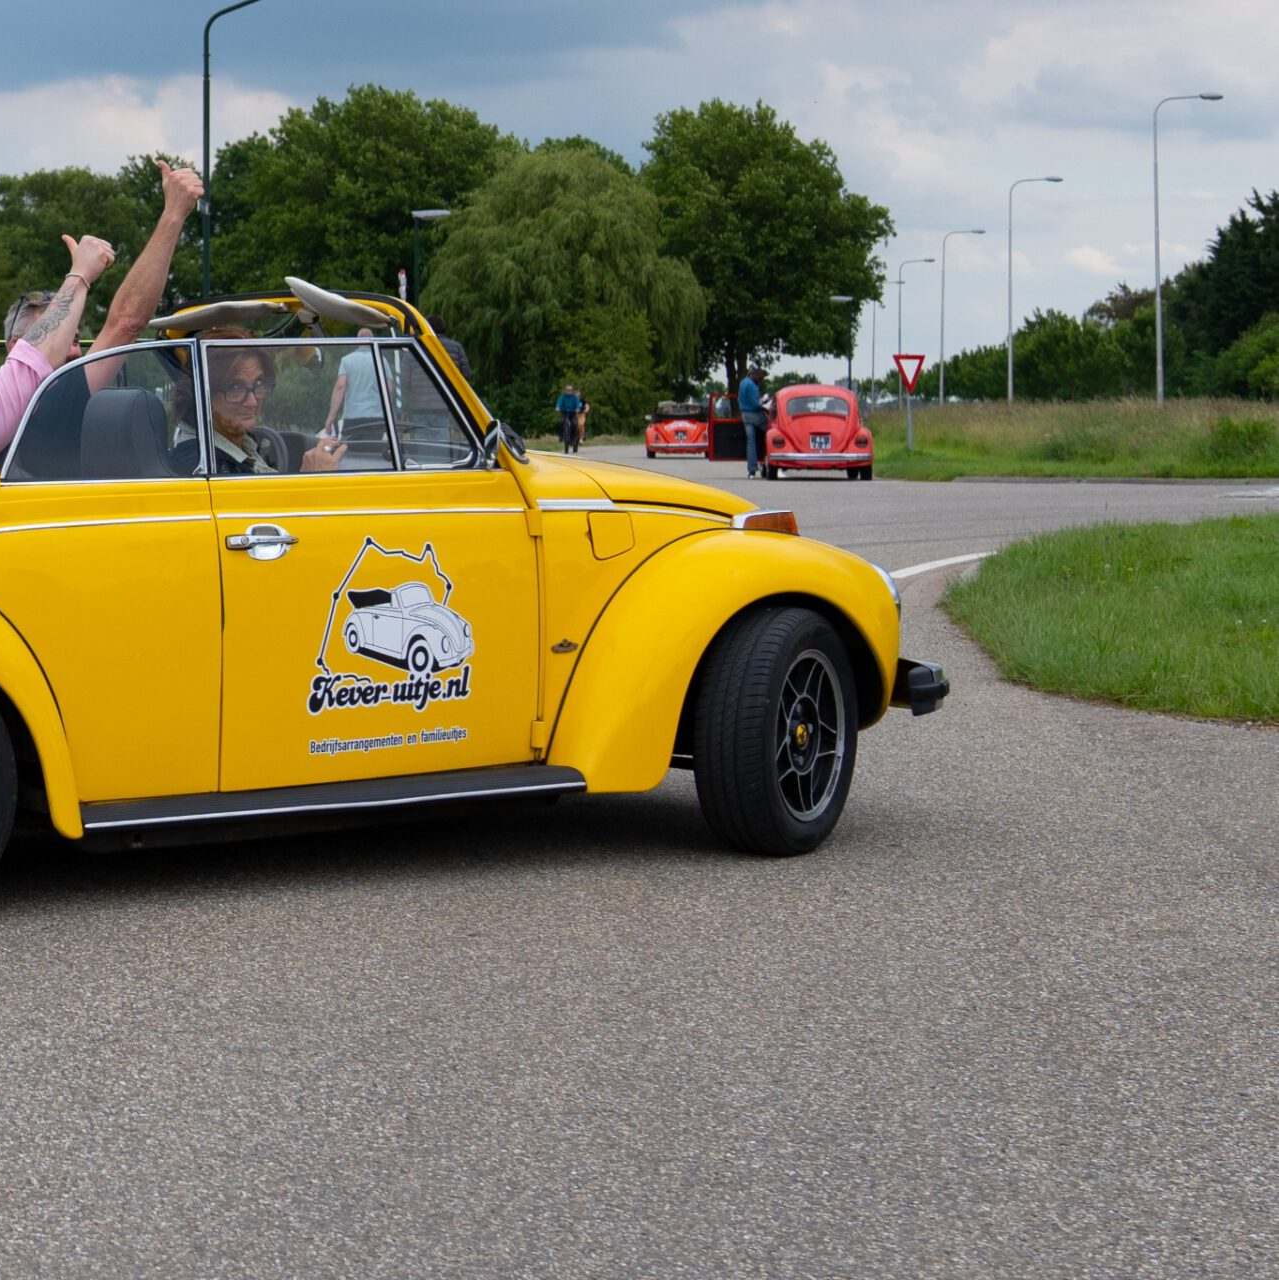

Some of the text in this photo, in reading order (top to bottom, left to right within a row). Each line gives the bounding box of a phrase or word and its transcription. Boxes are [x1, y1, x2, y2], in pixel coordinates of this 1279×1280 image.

[309, 666, 470, 713] Kever-uitje.nl
[310, 727, 467, 754] Bedrijfsarrangementen en familieuitjes
